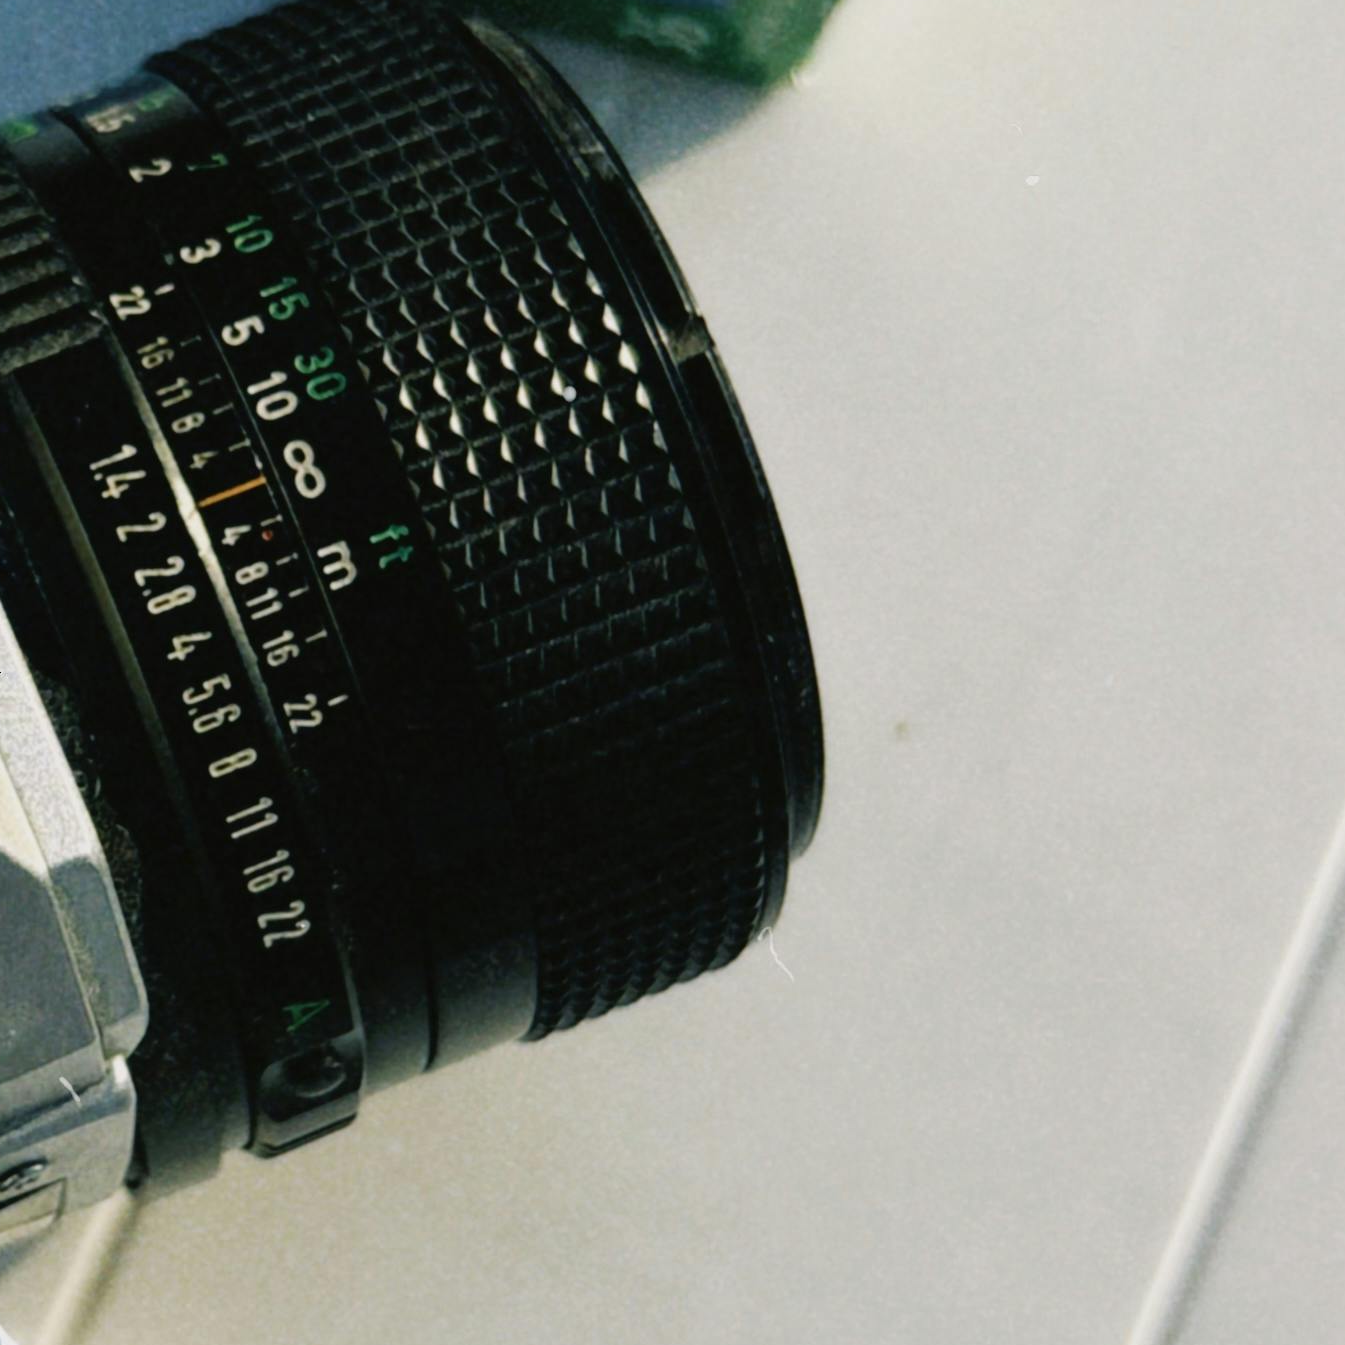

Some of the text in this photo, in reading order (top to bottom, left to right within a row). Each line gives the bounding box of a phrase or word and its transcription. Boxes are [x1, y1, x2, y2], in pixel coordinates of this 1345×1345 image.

[109, 286, 323, 735] 22 16 11 8 4 4 8 11 16 22
[128, 158, 173, 184] 2
[179, 238, 222, 264] 3
[221, 315, 265, 346] 5
[246, 371, 299, 421] 10
[316, 540, 357, 591] m
[225, 214, 275, 253] 10
[259, 276, 311, 321] 15
[293, 346, 347, 402] 30
[368, 523, 415, 570] ft
[89, 443, 331, 1034] 1.4 2 2.8 4 5.6 8 11 16 22 A
